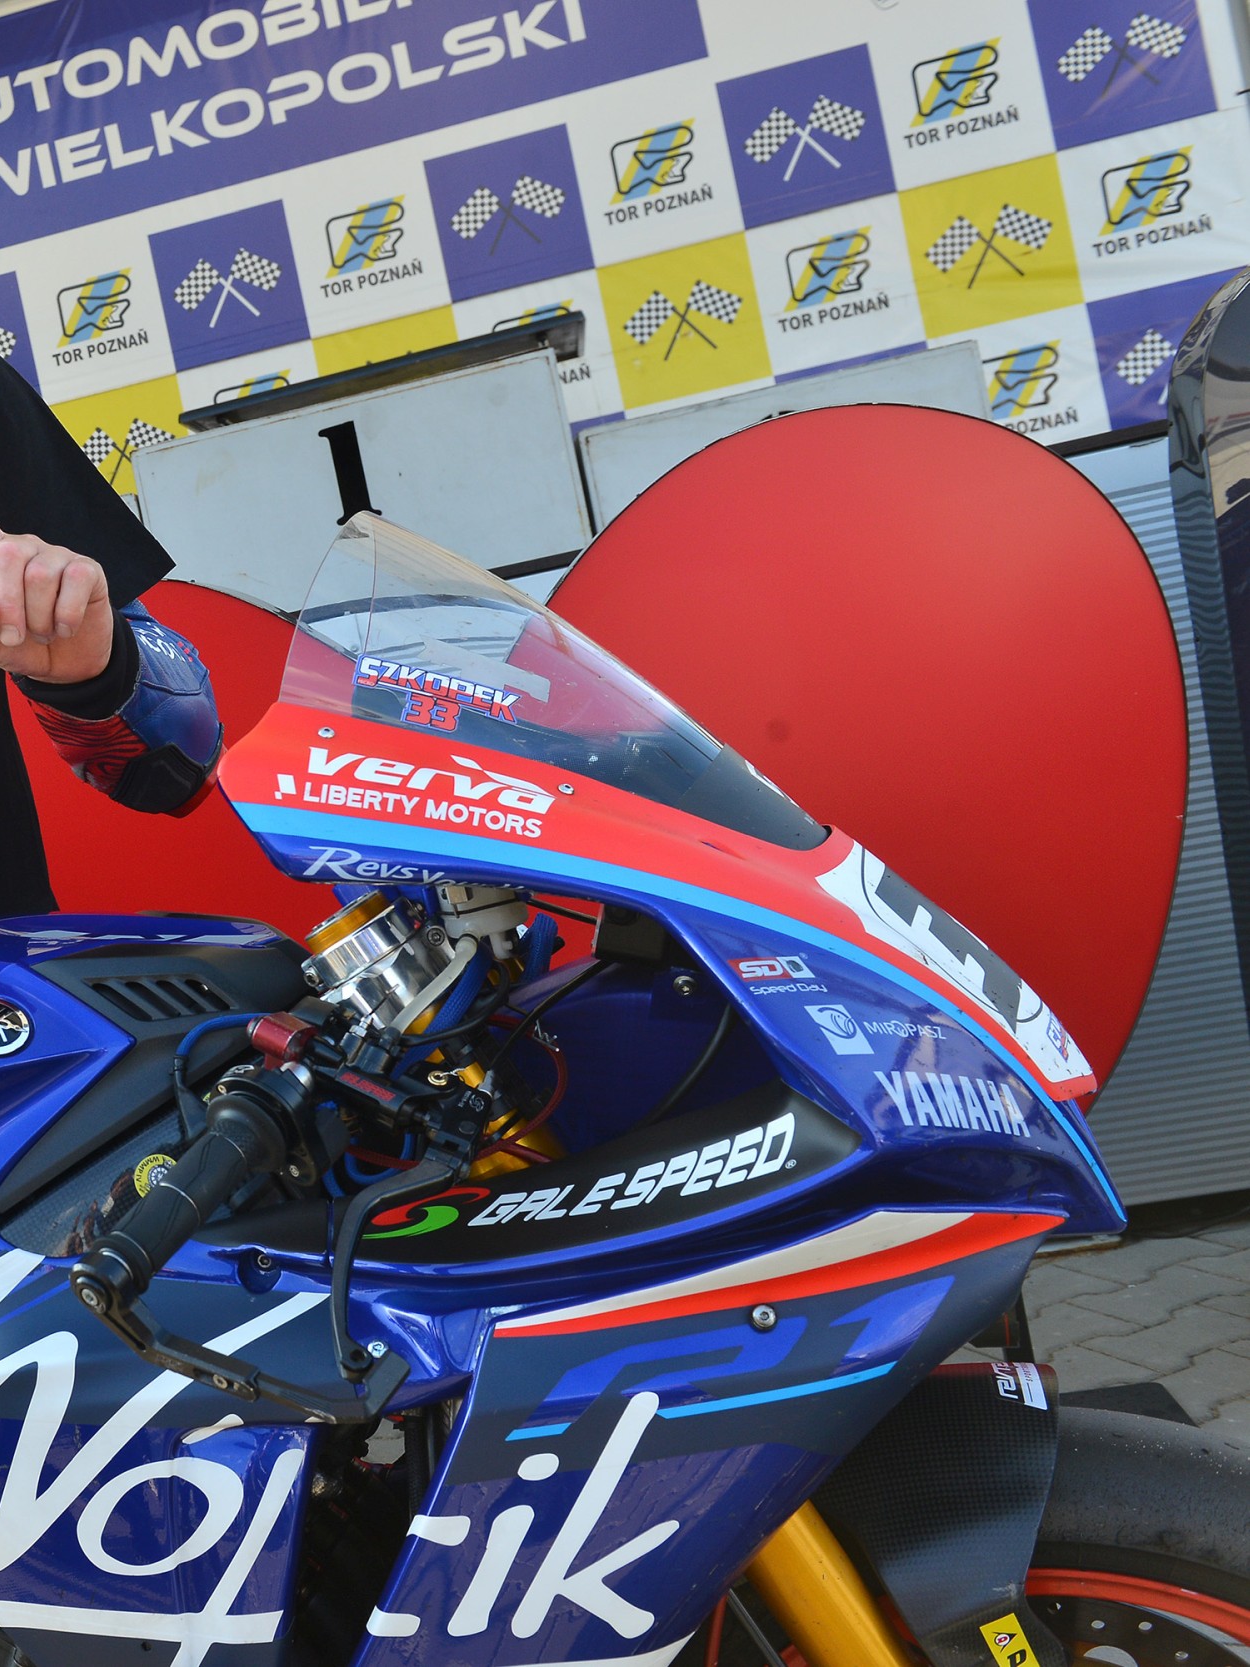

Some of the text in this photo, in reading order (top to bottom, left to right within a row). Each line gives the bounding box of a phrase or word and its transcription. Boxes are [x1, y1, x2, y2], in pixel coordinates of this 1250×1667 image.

[904, 104, 1019, 148] TOR POZNAŃ
[604, 183, 713, 225] TOR POZNAŃ
[1092, 214, 1212, 257] TOR POZNAŃ
[320, 258, 423, 298] TOR POZNAŃ
[778, 292, 890, 332] TOR POZNAŃ
[52, 328, 149, 366] TOR POZNAŃ
[318, 420, 382, 526] 1
[358, 656, 521, 723] SZKOPEK
[405, 692, 461, 732] 33
[303, 782, 543, 838] LIBERTY MOTORS
[750, 983, 828, 995] Speed Day
[863, 1019, 947, 1040] MIROPASZ
[874, 1071, 1031, 1137] YAMAHA
